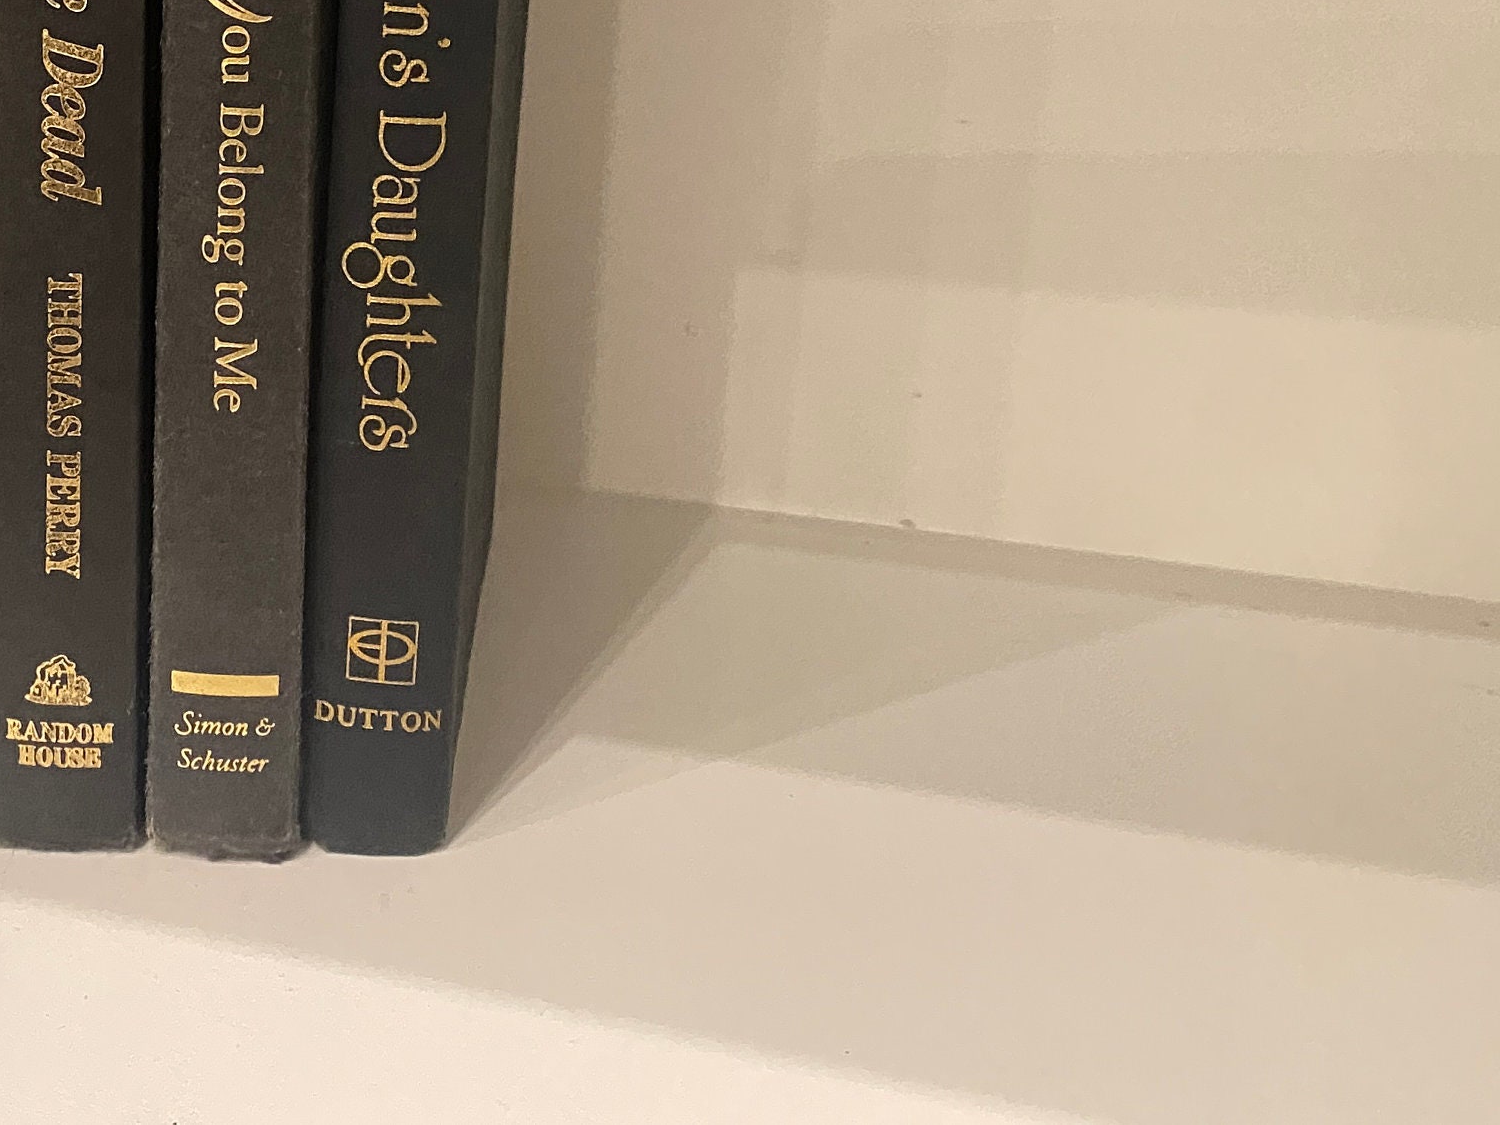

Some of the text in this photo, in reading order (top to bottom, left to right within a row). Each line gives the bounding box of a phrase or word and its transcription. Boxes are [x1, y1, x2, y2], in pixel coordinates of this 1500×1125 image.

[41, 29, 104, 205] Dead
[202, 103, 264, 265] Belong
[342, 110, 446, 451] Daughters
[214, 281, 248, 326] to
[213, 337, 257, 412] Me
[45, 273, 82, 579] THOMAS PERRY
[6, 718, 114, 745] RANDOM
[174, 711, 276, 737] Simon &
[314, 700, 441, 732] DUTTON
[18, 745, 102, 769] HOUSE
[177, 748, 269, 772] Schuster
